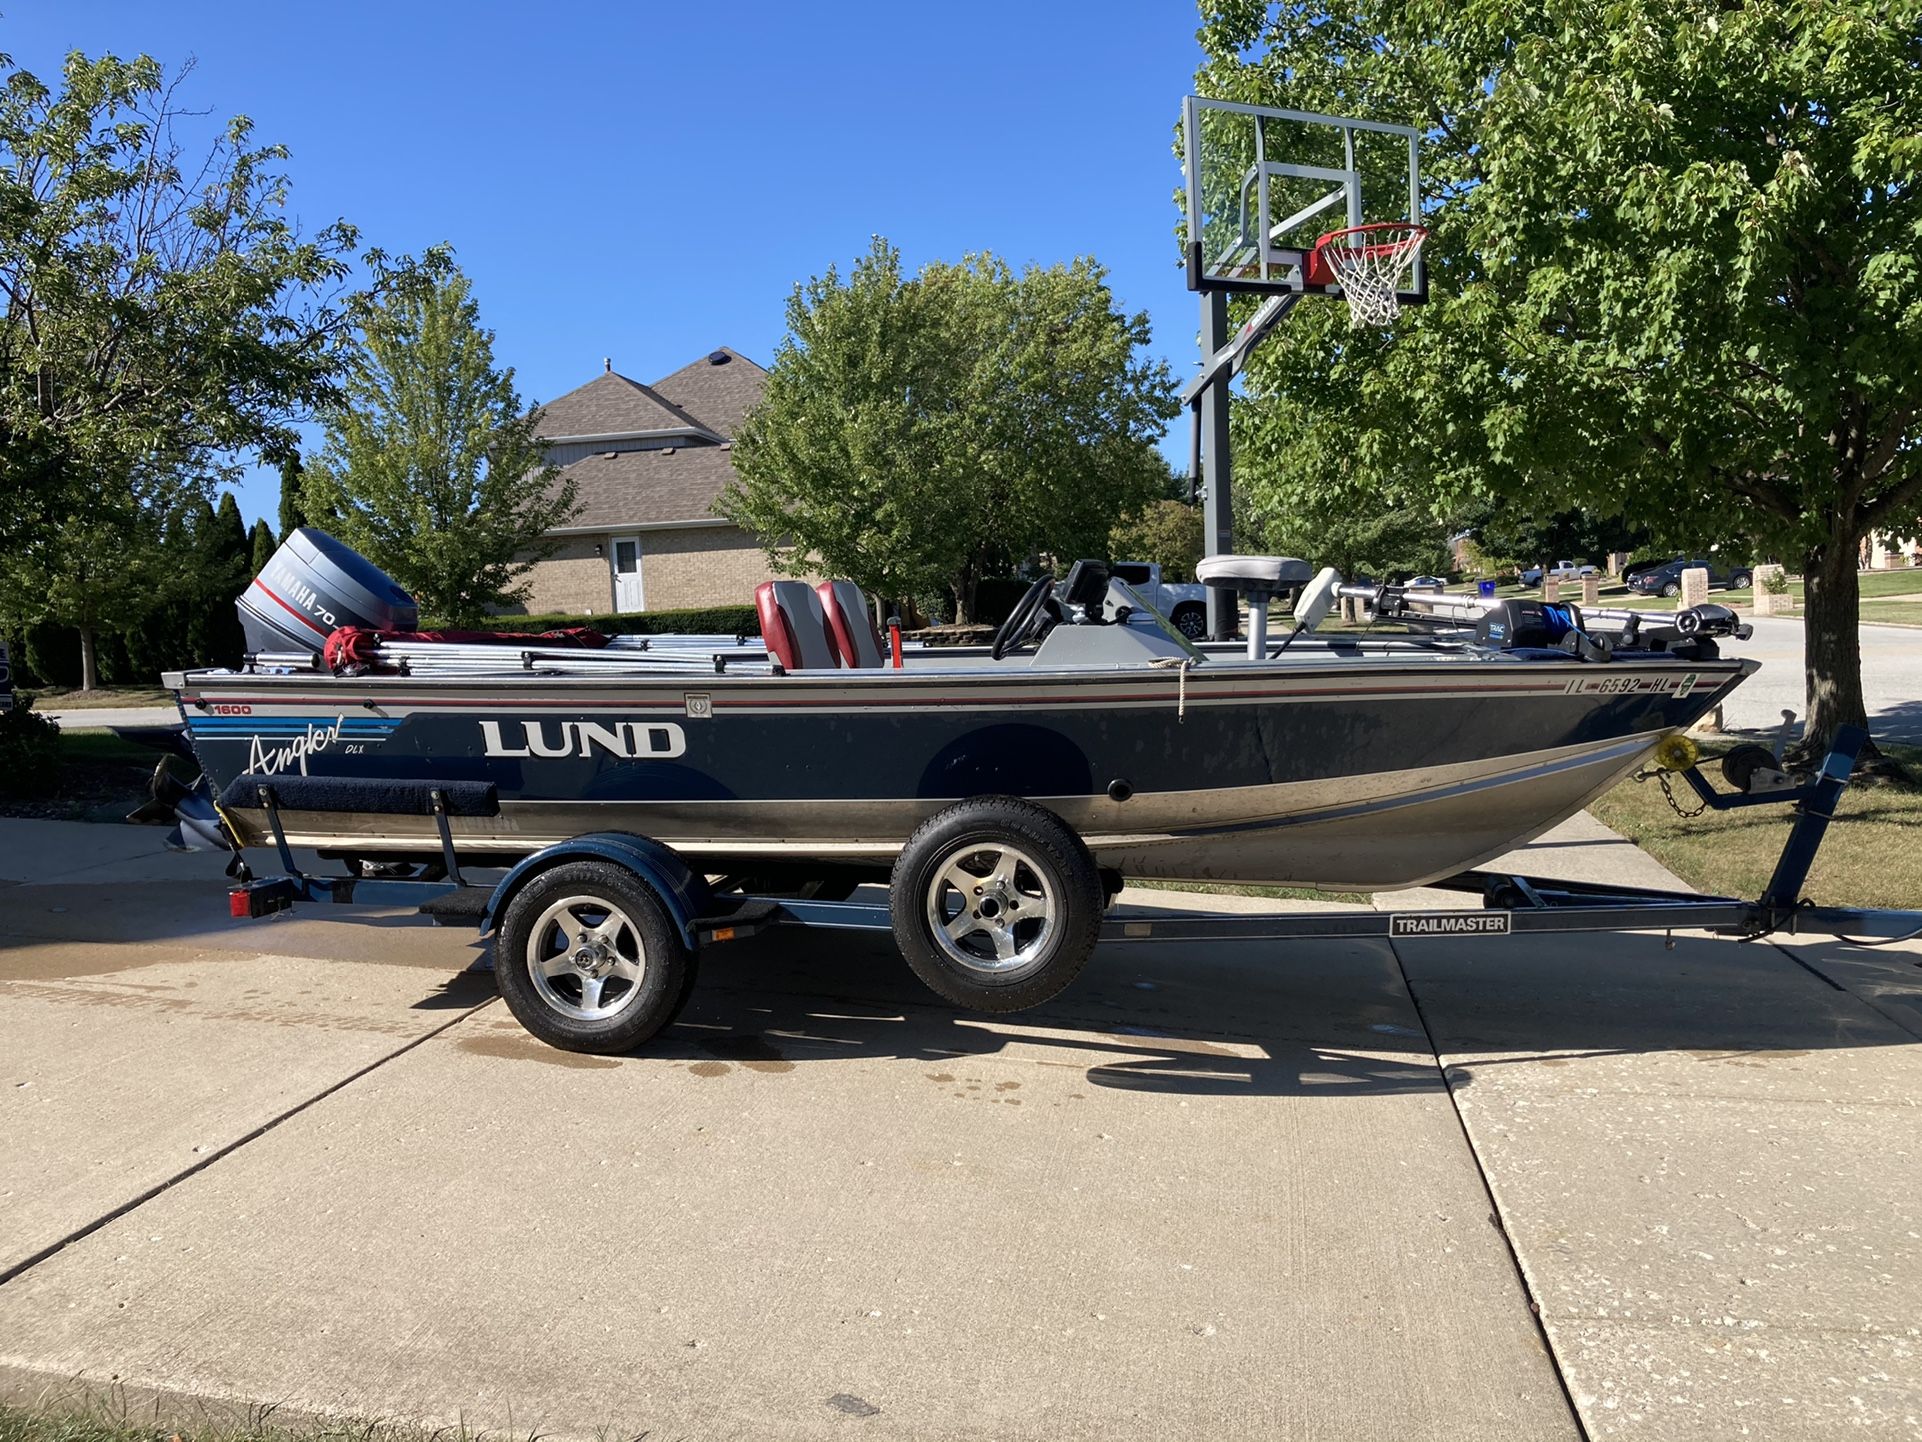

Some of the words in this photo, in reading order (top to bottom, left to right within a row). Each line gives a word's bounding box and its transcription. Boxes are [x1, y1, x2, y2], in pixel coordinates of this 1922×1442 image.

[270, 561, 317, 611] YAMAHA
[313, 604, 336, 626] 70
[1489, 623, 1505, 633] TRAC
[1566, 679, 1584, 694] IL
[1599, 678, 1641, 693] 6592
[1650, 678, 1668, 692] HL
[214, 705, 252, 715] 1600
[242, 712, 344, 776] Angler
[478, 721, 686, 758] LUND
[344, 745, 364, 754] DLX
[1396, 917, 1505, 932] TRAILMASTER
